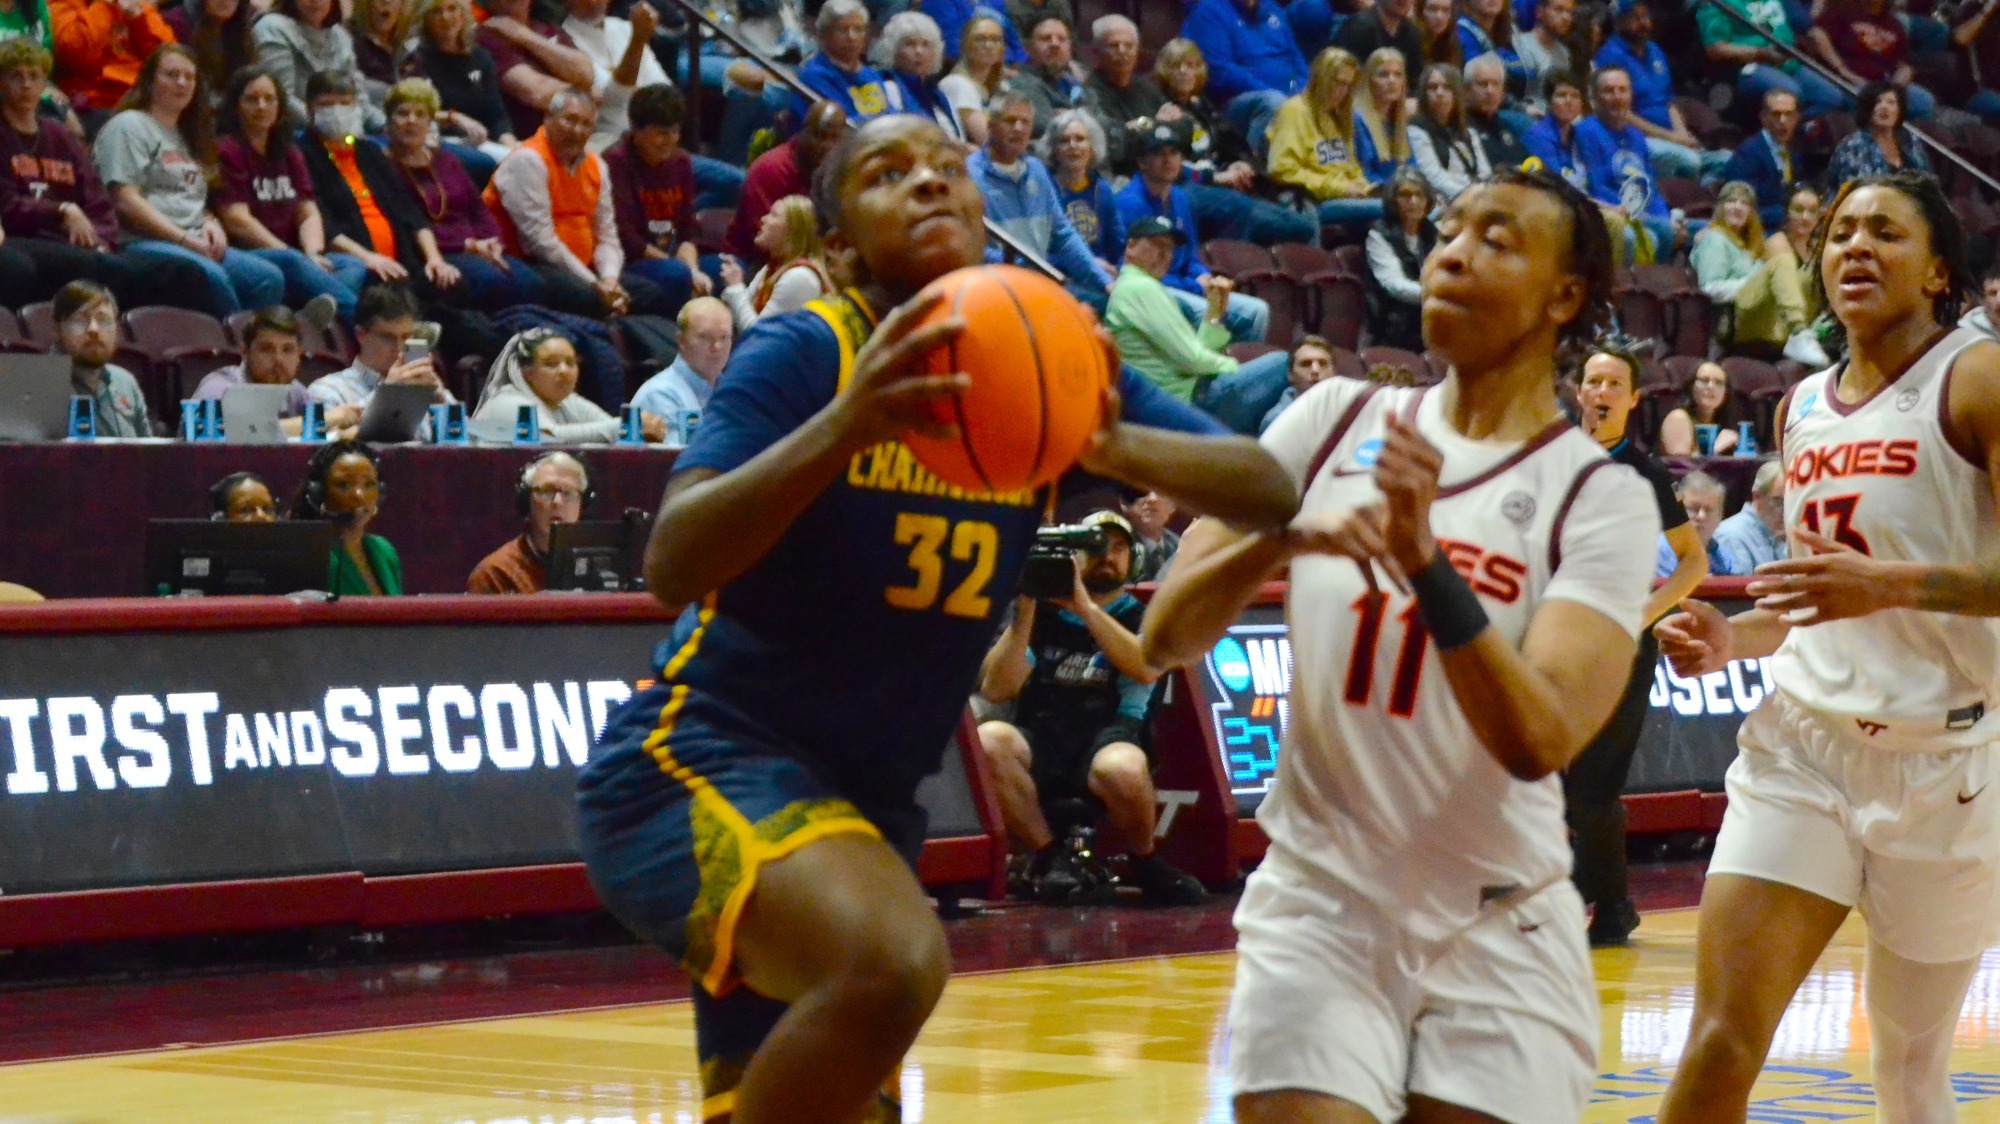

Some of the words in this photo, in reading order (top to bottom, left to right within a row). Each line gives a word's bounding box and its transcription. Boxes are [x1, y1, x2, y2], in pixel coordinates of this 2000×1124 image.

[1801, 493, 1872, 558] 13
[884, 511, 998, 620] 32
[1342, 587, 1432, 720] 11
[224, 710, 327, 770] AND
[1855, 717, 1888, 736] VT
